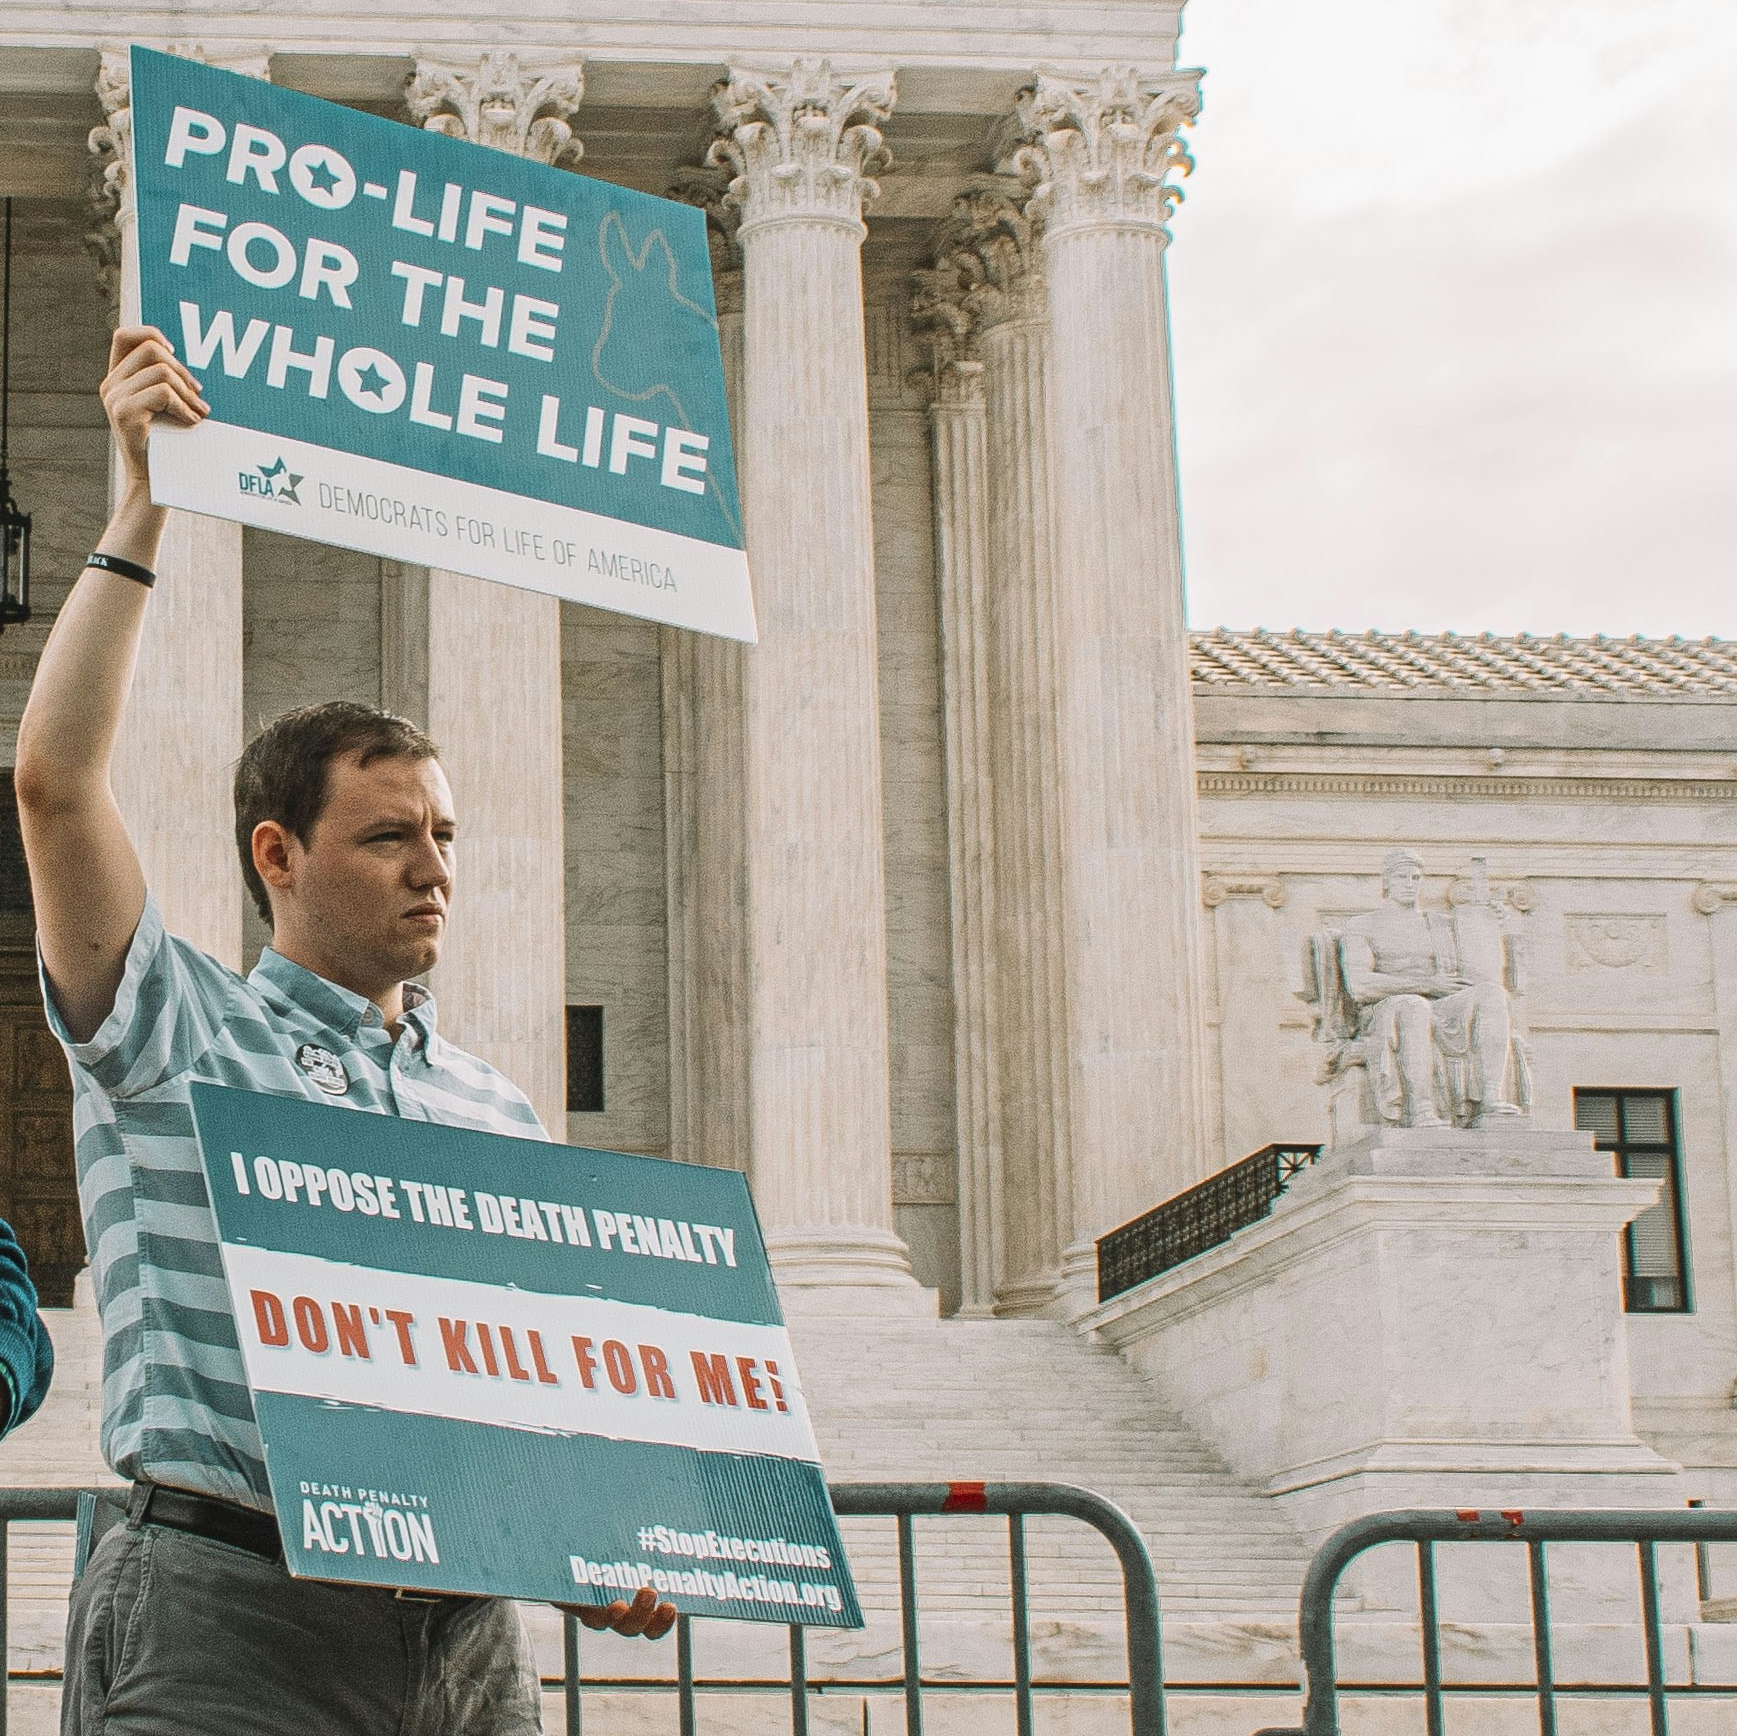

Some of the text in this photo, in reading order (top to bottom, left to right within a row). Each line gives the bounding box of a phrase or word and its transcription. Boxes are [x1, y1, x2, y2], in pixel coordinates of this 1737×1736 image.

[164, 105, 568, 272] PRO-LIFE
[169, 203, 560, 363] FOR THE
[178, 301, 710, 495] WHOLE LIFE
[238, 472, 274, 498] DFLA
[318, 482, 449, 538] DEMOCRATS
[457, 516, 496, 548] FOR
[503, 527, 545, 562] LIFE
[553, 539, 578, 569] OF
[588, 547, 678, 594] AMERICA
[230, 1151, 738, 1268] I OPPOSE THE DEATH PENALTY
[249, 1289, 791, 1413] DON'T KILL FOR ME!
[299, 1481, 429, 1508] DEATH PENALTY
[303, 1498, 440, 1564] ACTION
[637, 1524, 832, 1570] #StopExecutions
[569, 1554, 843, 1612] DeathPenaltyAction.org
